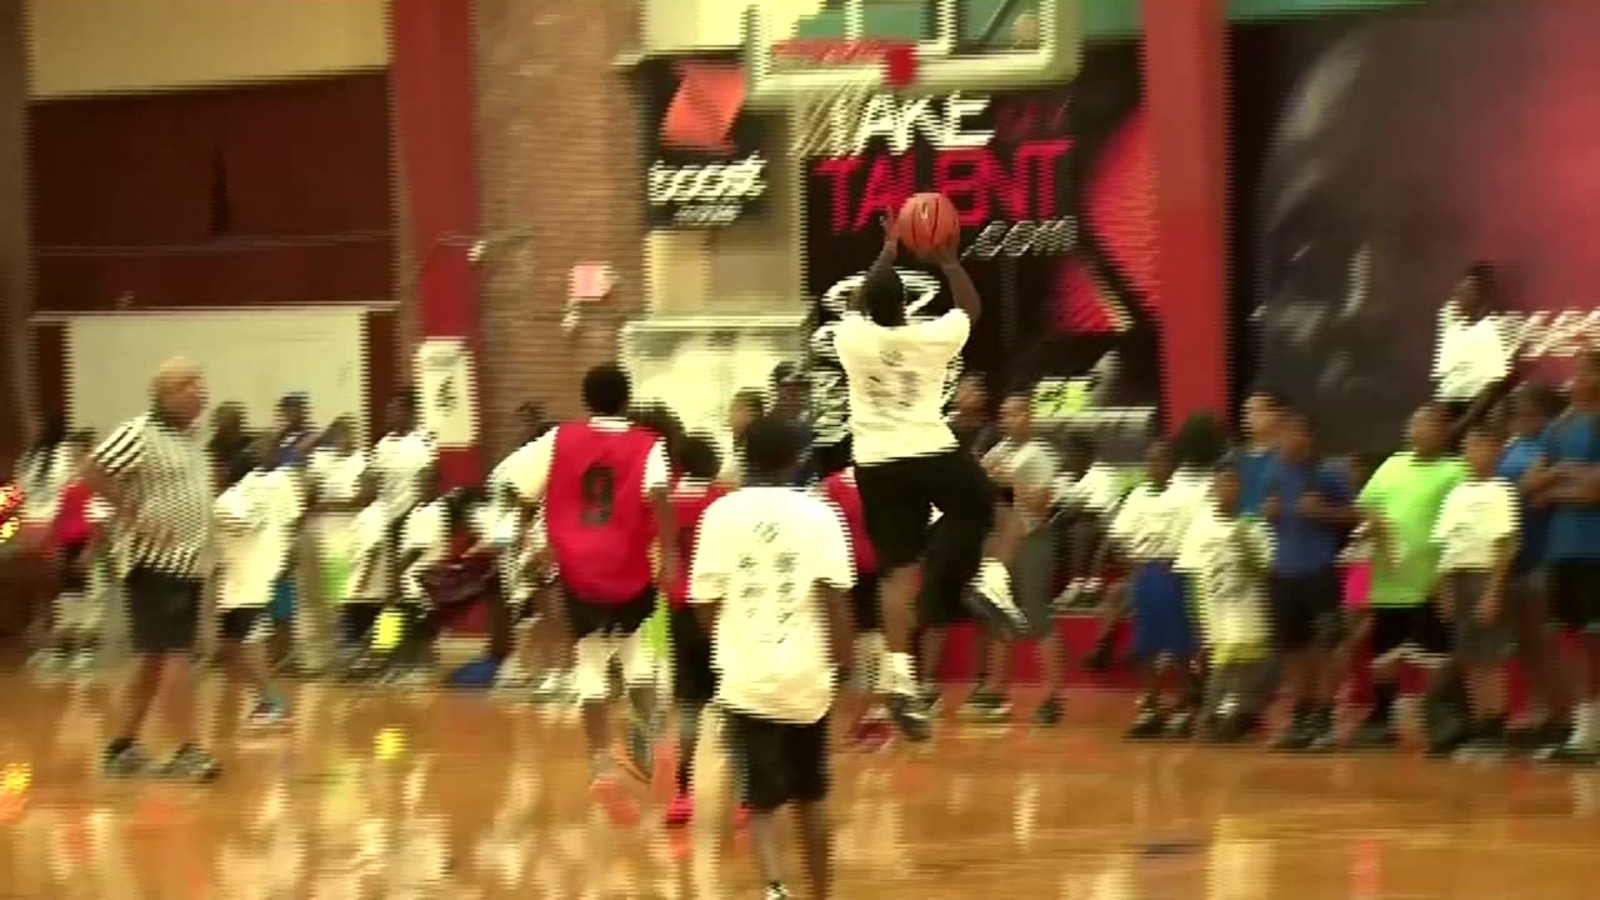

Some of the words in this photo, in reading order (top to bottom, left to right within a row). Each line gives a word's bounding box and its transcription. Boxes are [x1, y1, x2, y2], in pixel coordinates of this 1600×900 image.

[647, 152, 768, 204] boost
[813, 140, 1074, 235] TALENT
[578, 464, 617, 527] 9
